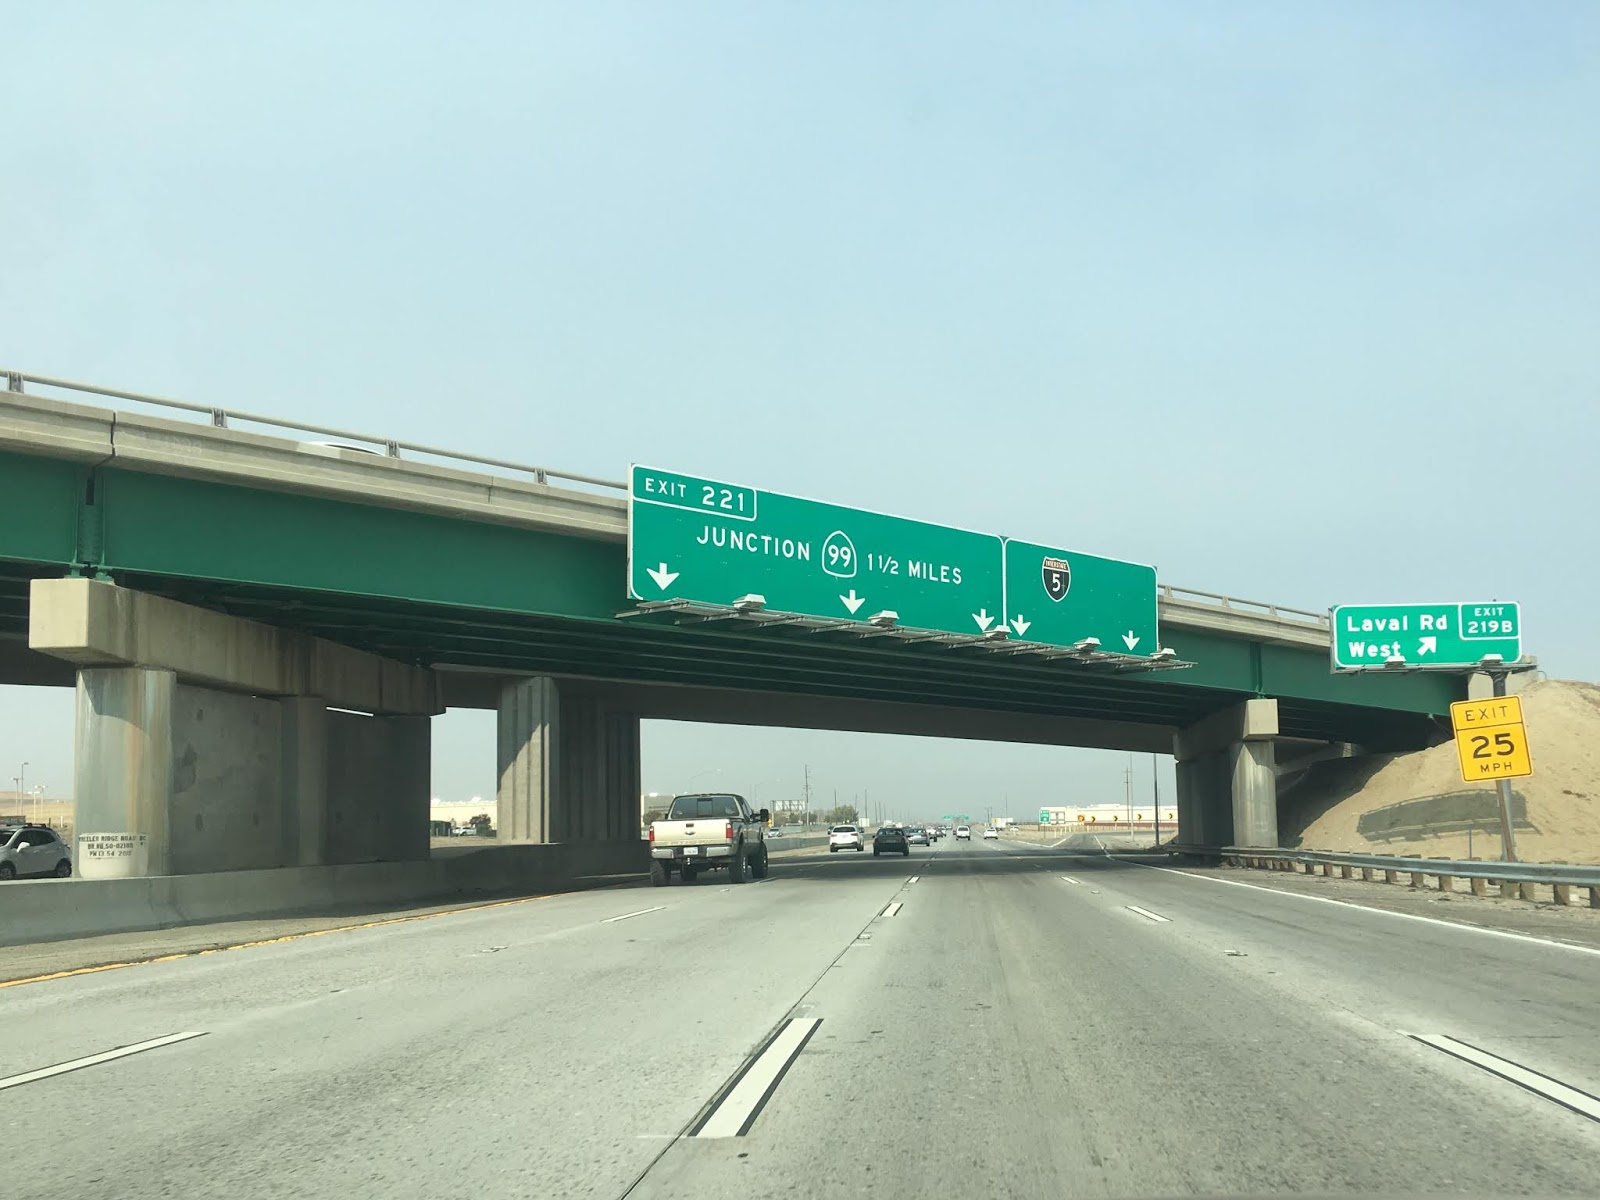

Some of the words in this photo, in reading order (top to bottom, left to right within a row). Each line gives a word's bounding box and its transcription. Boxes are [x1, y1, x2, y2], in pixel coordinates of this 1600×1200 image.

[645, 477, 687, 498] EXIT
[702, 486, 744, 512] 221
[696, 525, 810, 561] JUNCTION
[828, 544, 851, 568] 99
[908, 560, 962, 585] MILES
[1052, 573, 1061, 592] 5
[1474, 607, 1504, 617] EXIT
[1347, 614, 1408, 632] Laval
[1420, 614, 1448, 631] Rd
[1467, 620, 1513, 634] 219B
[1348, 641, 1401, 658] West
[1465, 705, 1508, 722] EXIT
[1471, 732, 1515, 759] 25
[1480, 762, 1513, 773] MPH
